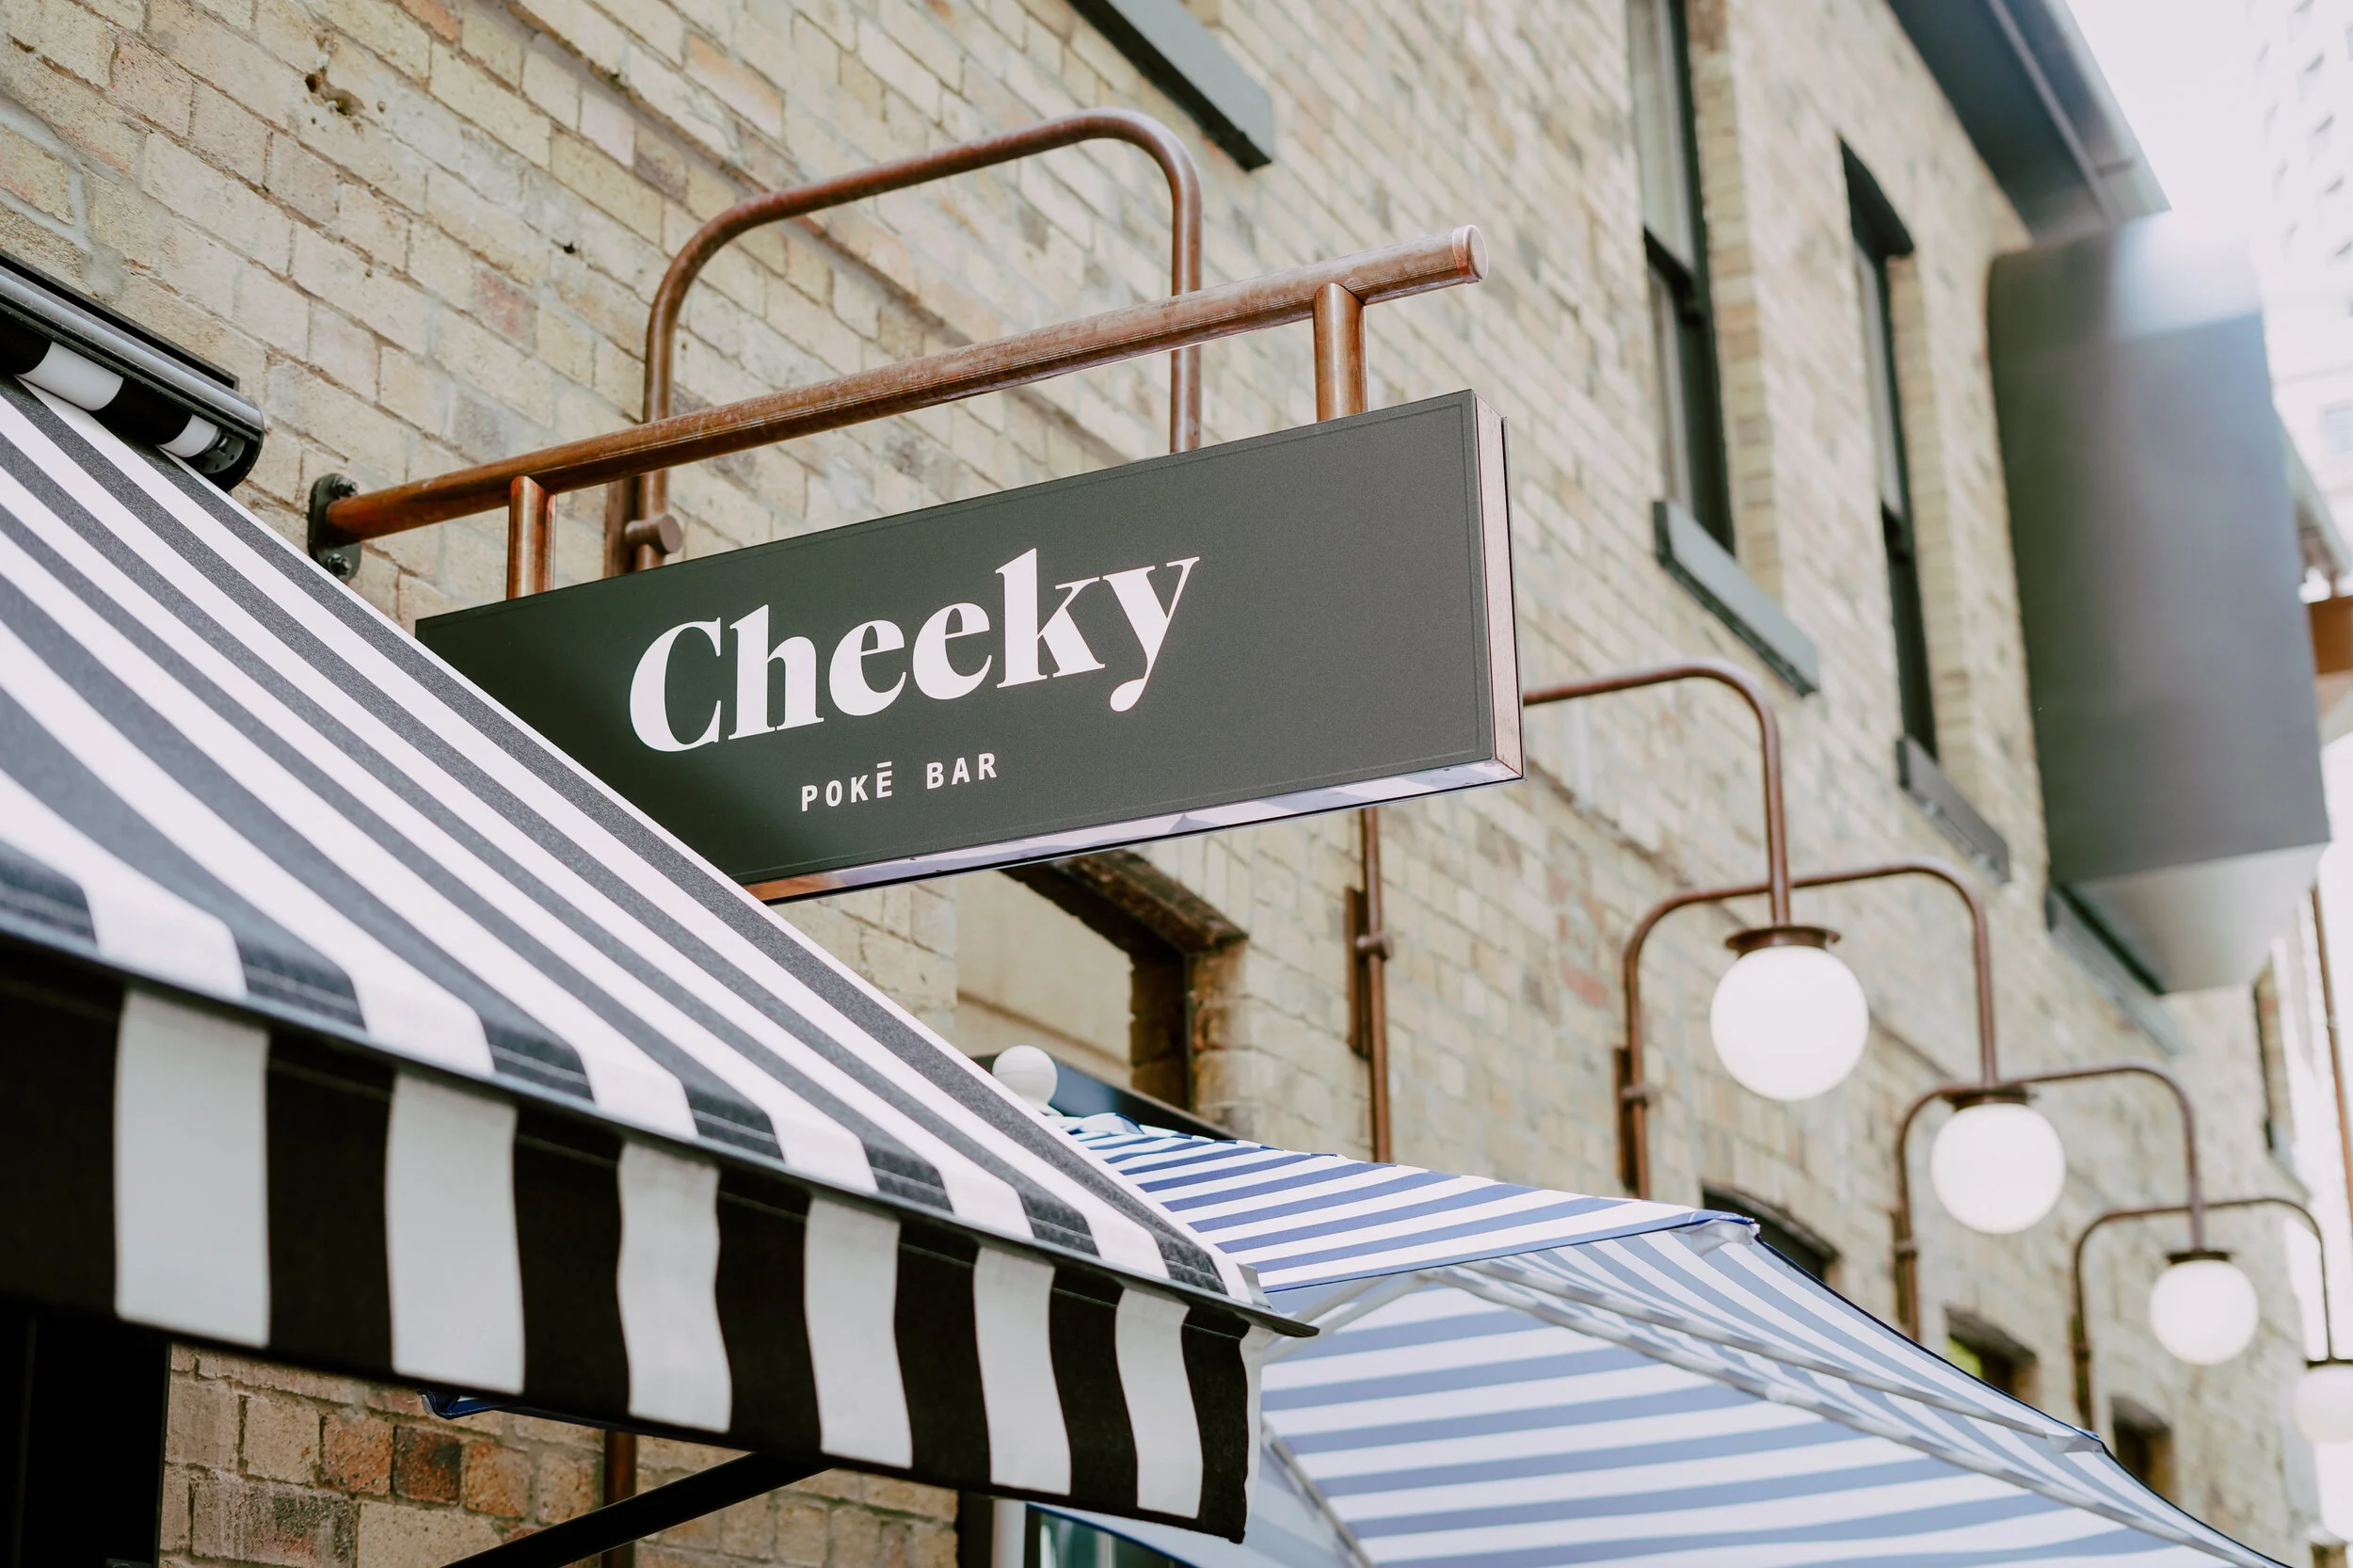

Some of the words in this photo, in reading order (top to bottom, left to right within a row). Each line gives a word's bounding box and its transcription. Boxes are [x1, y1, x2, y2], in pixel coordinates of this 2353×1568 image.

[629, 547, 1201, 752] Cheeky
[801, 760, 893, 812] POKĒ
[926, 752, 998, 790] BAR
